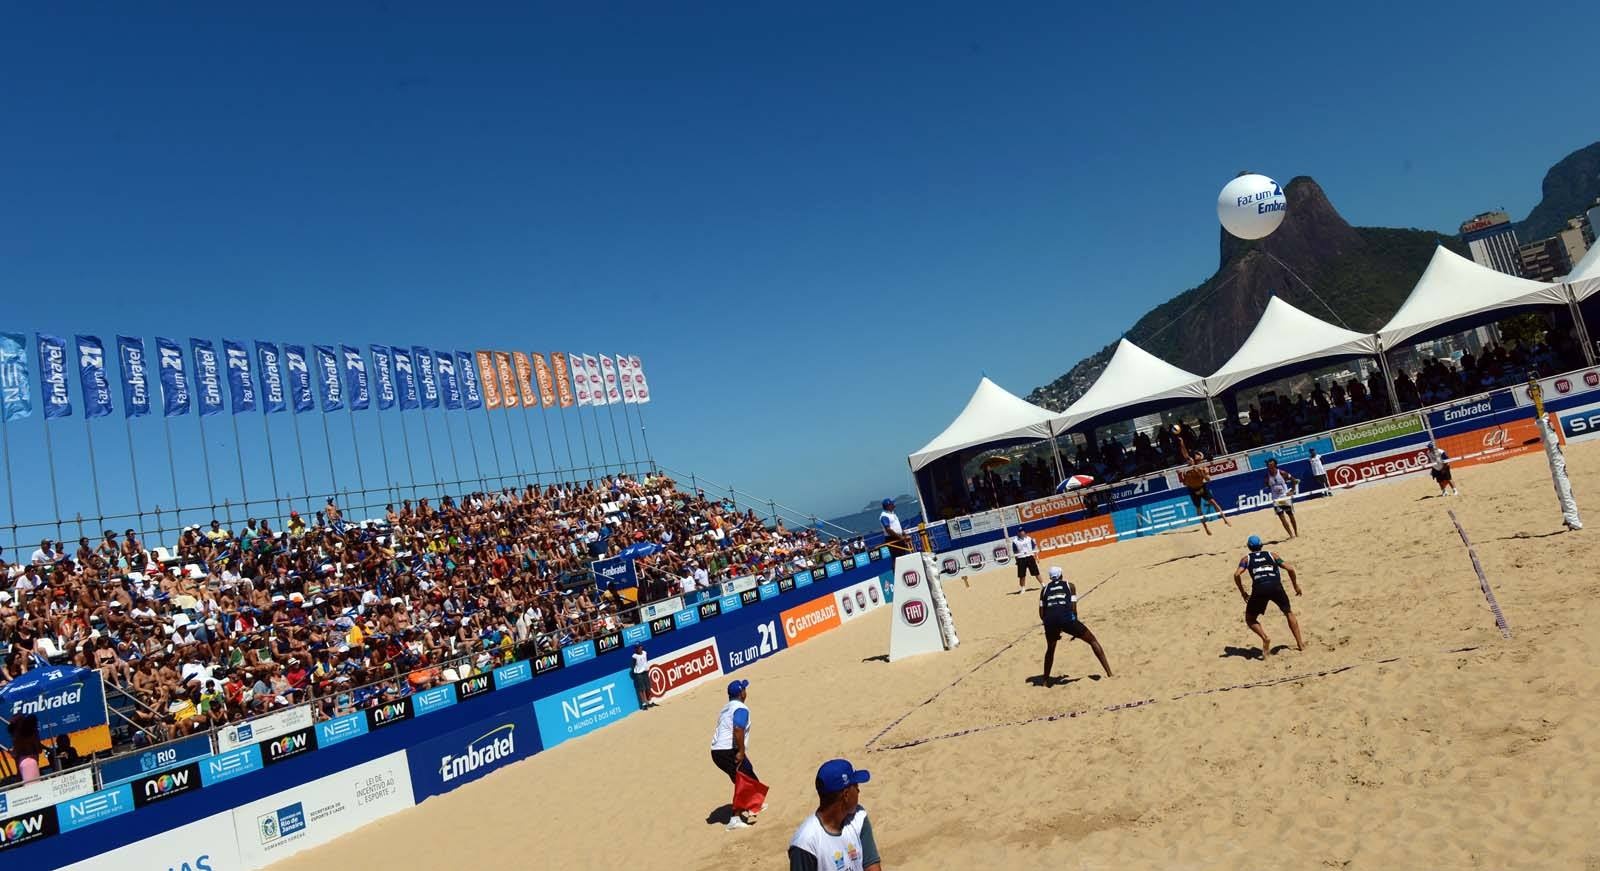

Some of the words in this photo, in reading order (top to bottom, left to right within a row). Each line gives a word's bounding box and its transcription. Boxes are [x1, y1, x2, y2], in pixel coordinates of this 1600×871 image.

[1237, 195, 1253, 207] Faz
[1255, 191, 1271, 200] um
[80, 346, 103, 369] 21
[160, 348, 182, 369] 21
[228, 349, 248, 371] 21
[287, 353, 308, 374] 21
[344, 353, 365, 373] 21
[395, 354, 413, 373] 21
[438, 358, 454, 375] 21
[0, 348, 20, 403] NET
[47, 346, 68, 405] Embratel
[94, 371, 105, 386] um
[128, 348, 146, 405] Embratel
[203, 349, 220, 405] Embratel
[241, 373, 251, 387] um
[264, 350, 282, 403] Embratel
[321, 353, 340, 404] Embratel
[379, 354, 393, 402] Embratel
[420, 356, 437, 401] Embratel
[463, 359, 480, 402] Embratel
[98, 388, 108, 404] Faz
[243, 388, 253, 402] Faz
[1444, 402, 1491, 421] Embratel
[1336, 418, 1419, 446] globoesporte.com
[1483, 428, 1514, 446] GOL
[1360, 451, 1429, 480] piraquê
[1121, 490, 1132, 498] um
[1133, 479, 1149, 495] 21
[1022, 506, 1034, 518] G
[1136, 502, 1189, 527] NET
[1040, 524, 1110, 549] GATORADE
[602, 565, 626, 577] Embratel
[904, 572, 918, 585] FIAT
[678, 610, 695, 623] NET
[786, 616, 798, 638] G
[795, 604, 837, 631] GATORADE
[905, 604, 922, 620] FIAT
[627, 625, 647, 638] NET
[654, 618, 671, 632] now
[568, 645, 589, 658] NET
[599, 635, 619, 650] now
[729, 650, 744, 668] Faz
[744, 645, 759, 661] um
[757, 620, 779, 657] 21
[536, 654, 558, 670] now
[667, 650, 715, 686] piraquê
[500, 666, 524, 681] NET
[461, 676, 488, 694] now
[13, 688, 81, 714] Embratel
[419, 687, 449, 706] NET
[562, 682, 615, 723] NET
[374, 702, 405, 722] now
[324, 715, 359, 736] NET
[270, 733, 307, 756] now
[157, 748, 177, 763] RIO
[209, 750, 252, 775] NET
[440, 731, 515, 782] Embratel
[145, 769, 189, 796] now
[356, 781, 386, 798] INCENTIVO
[386, 778, 395, 787] AO
[366, 777, 375, 786] LEI
[375, 773, 382, 782] DE
[69, 789, 121, 819] NET
[365, 788, 389, 803] ESPORTE
[281, 820, 291, 828] Rio
[291, 816, 299, 824] de
[281, 821, 304, 833] Janeiro
